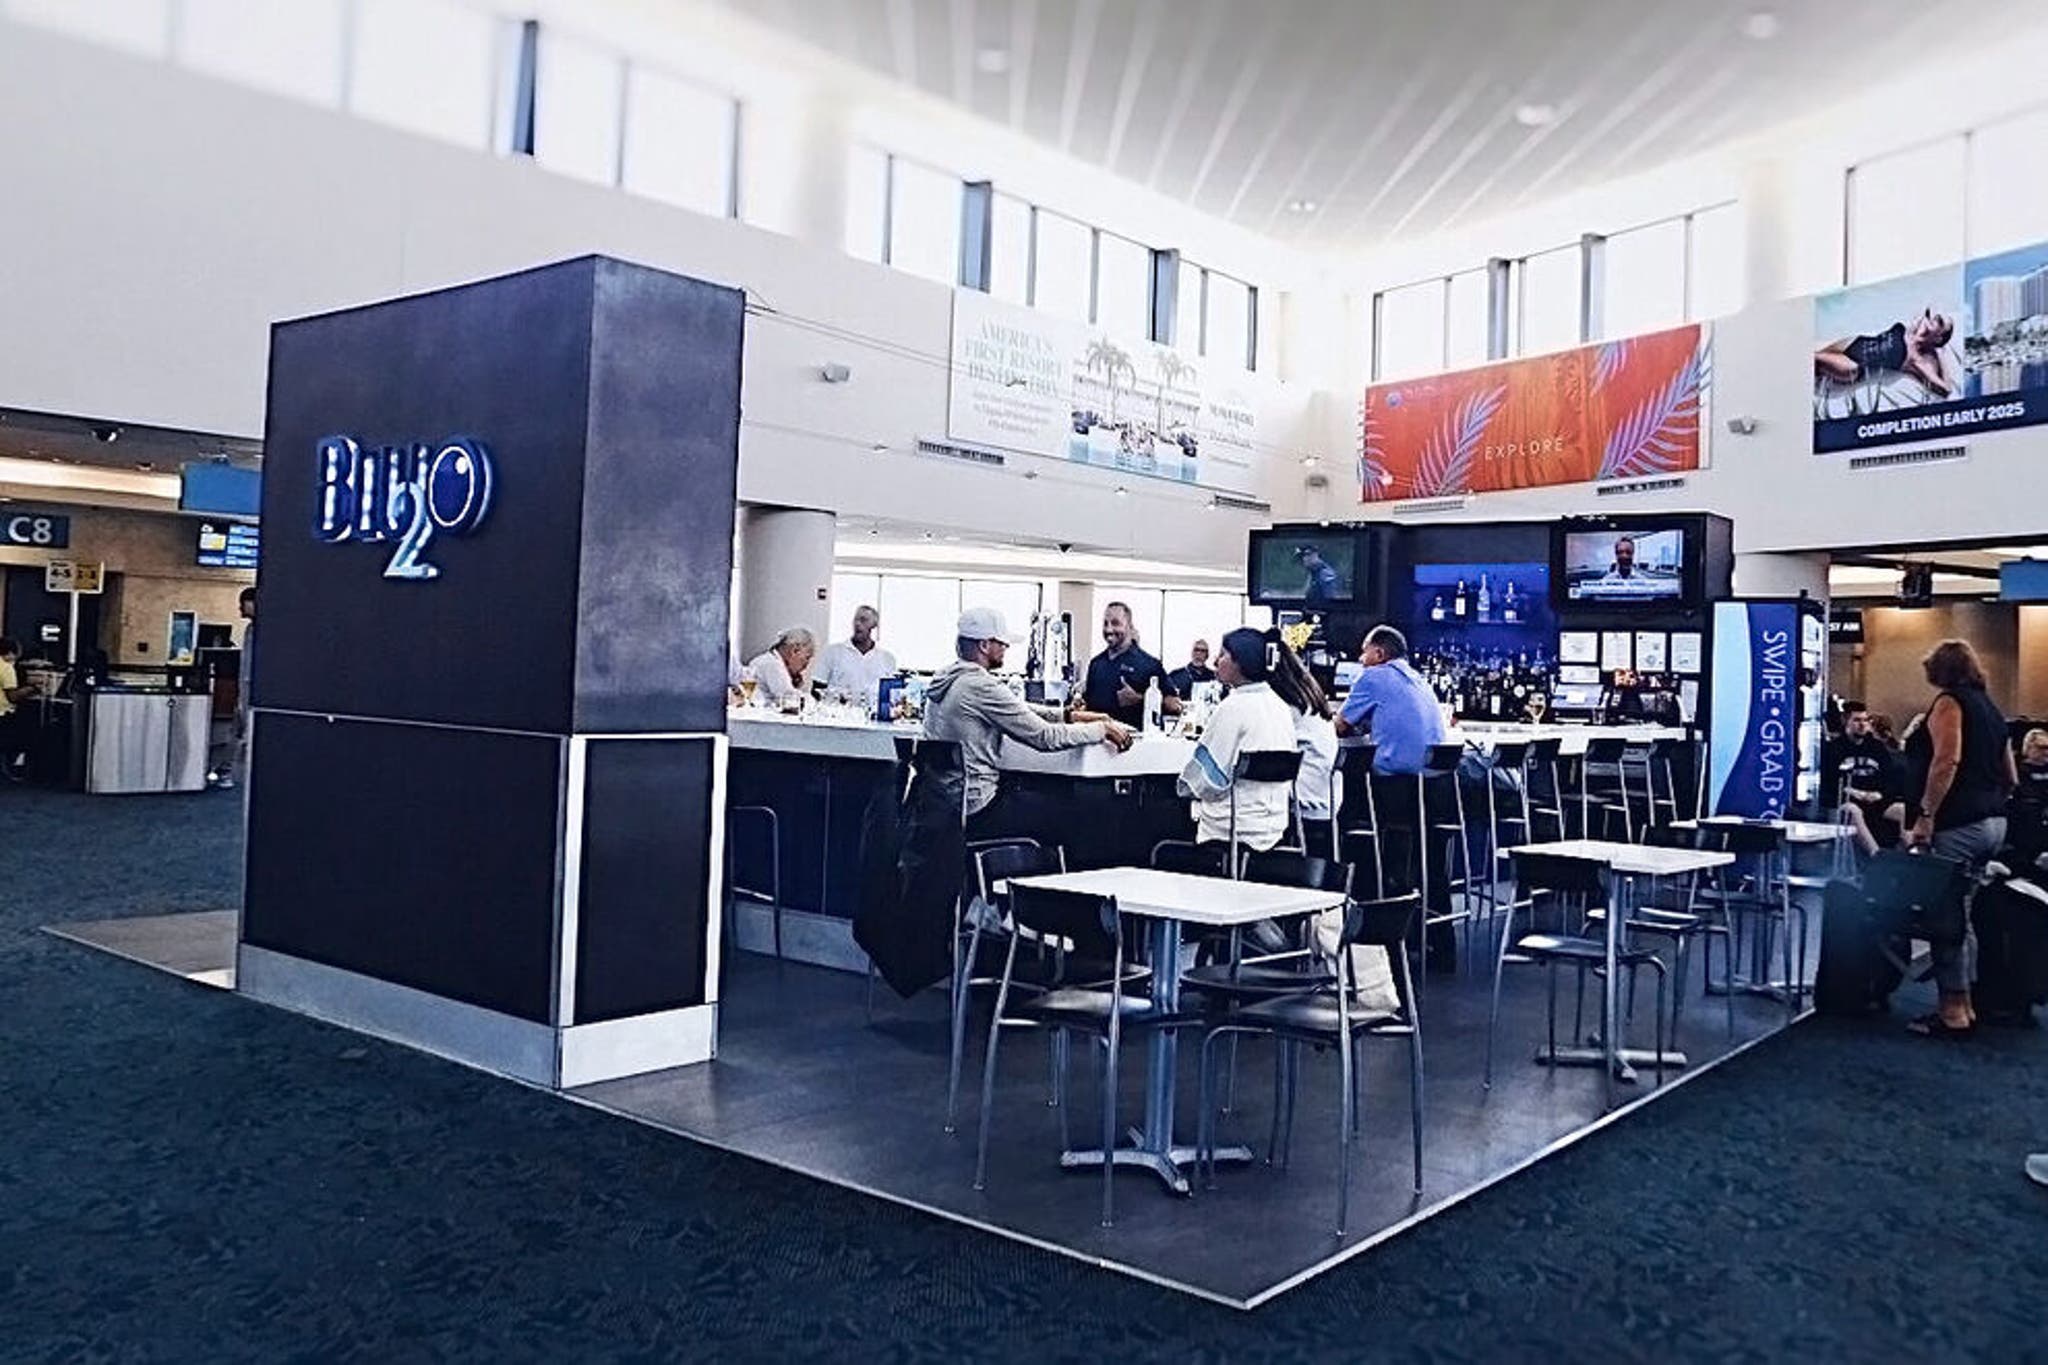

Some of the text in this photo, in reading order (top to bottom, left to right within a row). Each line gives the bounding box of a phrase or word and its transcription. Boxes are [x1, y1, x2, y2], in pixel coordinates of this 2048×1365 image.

[1857, 401, 2025, 438] COMPLETION EARLY 2025
[1485, 438, 1562, 461] EXPLORE
[8, 516, 51, 543] C8
[1761, 630, 1788, 702] SWIPE
[1760, 719, 1785, 792] GRAB
